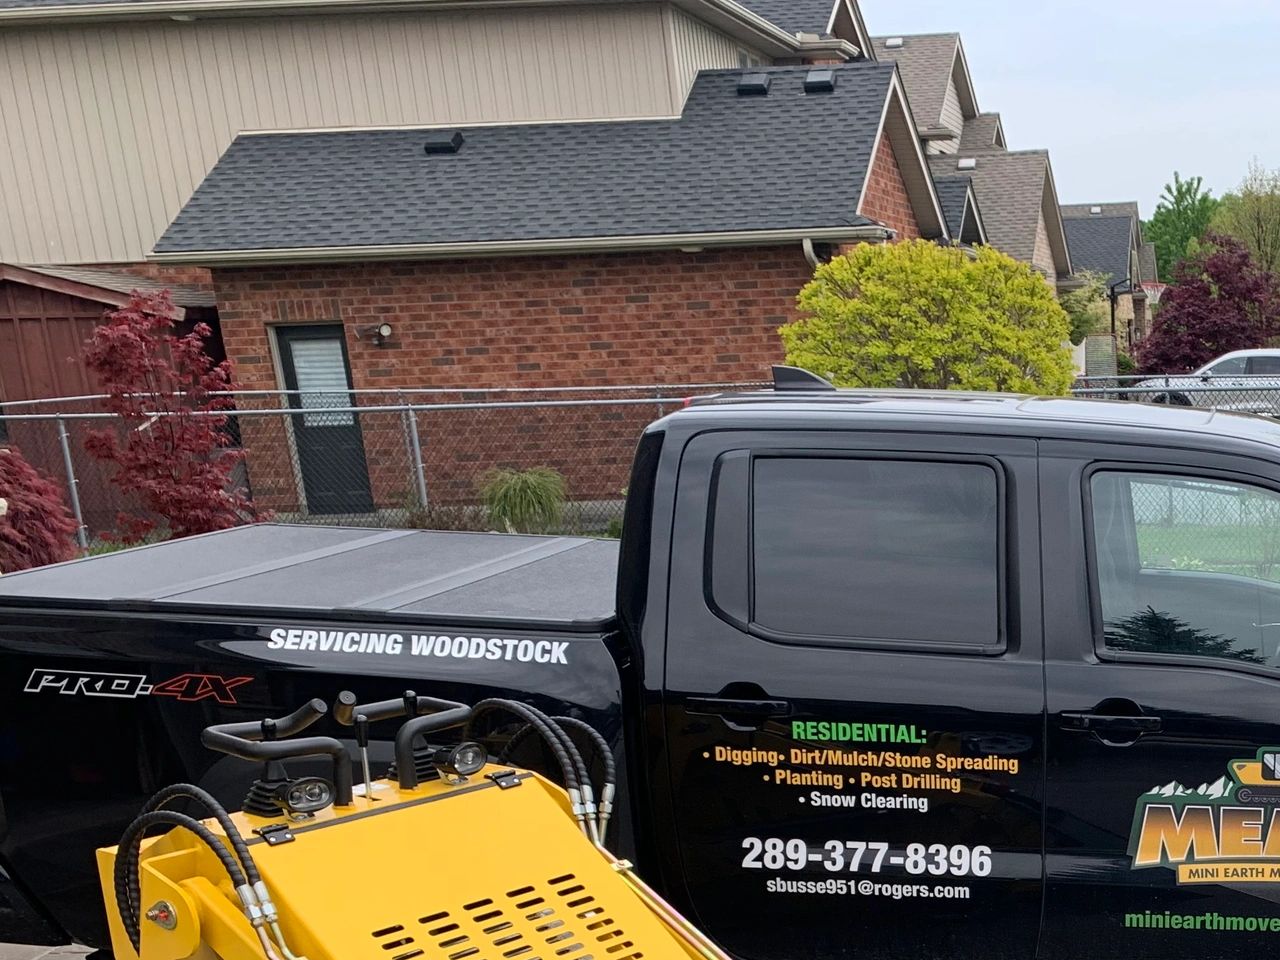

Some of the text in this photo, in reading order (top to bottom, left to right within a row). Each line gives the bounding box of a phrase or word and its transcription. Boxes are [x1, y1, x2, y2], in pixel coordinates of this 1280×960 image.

[267, 629, 569, 665] SERVICING WOODSTOCK
[792, 721, 927, 743] RESIDENTIAL:
[791, 750, 931, 769] Dirt/Mulch/Stone
[936, 753, 1018, 773] Spreading
[775, 770, 961, 792] Planting Post Drilling
[811, 792, 928, 812] Snow Clearing
[742, 837, 992, 877] 289-377-8396
[1189, 868, 1218, 879] MINI
[1224, 867, 1264, 878] EARTH
[767, 877, 969, 900] sbusse951@rogers.com
